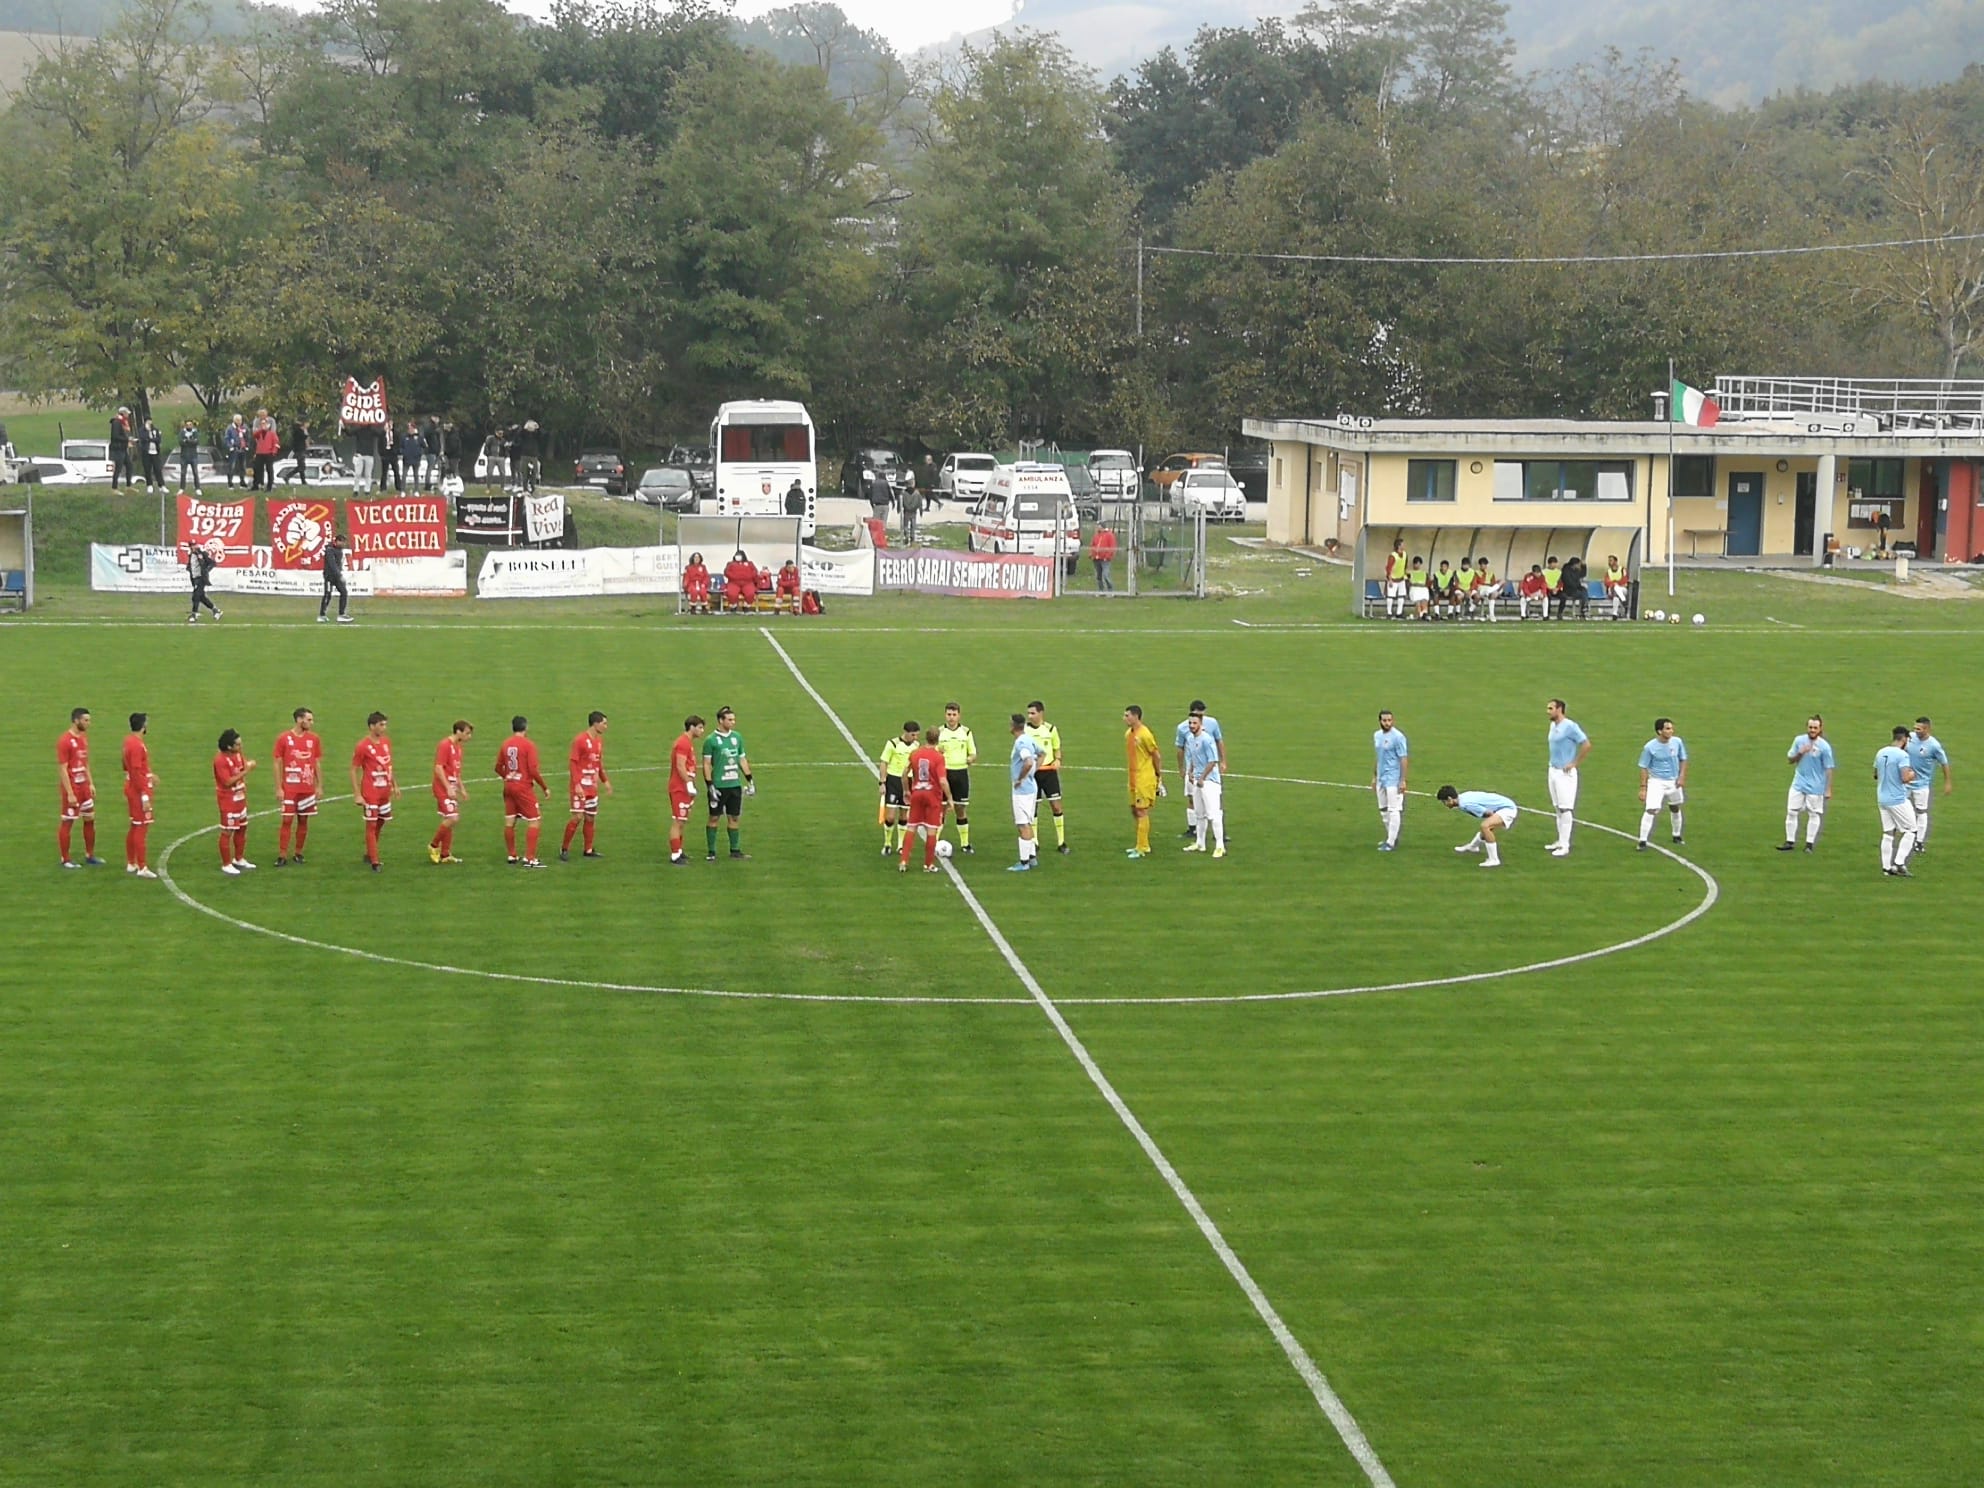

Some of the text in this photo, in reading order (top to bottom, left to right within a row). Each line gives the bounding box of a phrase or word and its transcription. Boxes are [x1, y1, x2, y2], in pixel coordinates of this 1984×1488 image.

[346, 392, 382, 409] GIDE
[342, 406, 386, 423] GIMO
[187, 499, 244, 518] Jesina
[354, 503, 440, 525] VECCHIA
[189, 516, 242, 537] 1927
[353, 531, 441, 552] MACCHIA
[236, 569, 276, 579] PESARO
[879, 557, 915, 585] FERRO
[916, 557, 951, 587] SARAI
[952, 561, 1000, 590] SEMPRE
[1002, 563, 1026, 590] CON
[1028, 565, 1049, 592] NOI
[507, 746, 519, 770] 3
